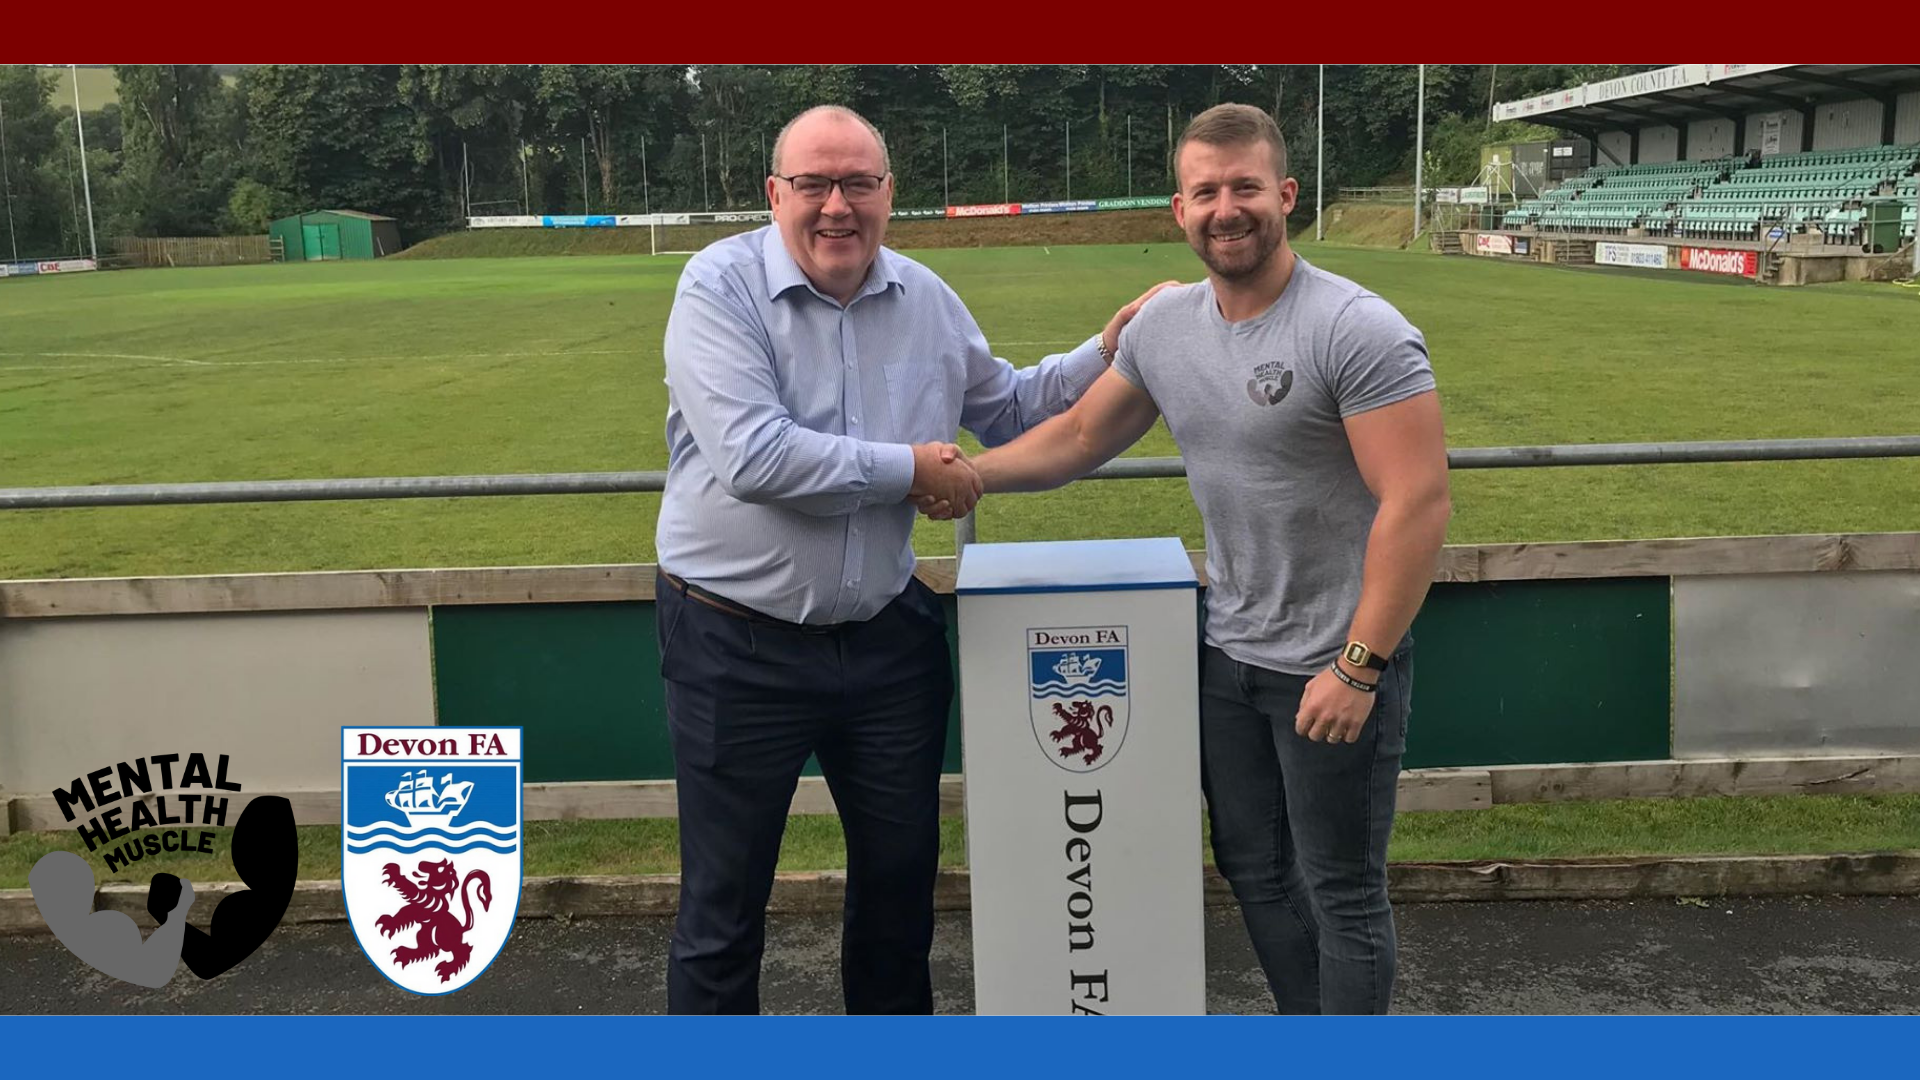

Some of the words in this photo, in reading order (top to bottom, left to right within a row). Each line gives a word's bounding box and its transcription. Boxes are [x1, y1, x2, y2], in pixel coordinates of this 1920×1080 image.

[1600, 81, 1626, 99] DEVON
[1630, 72, 1667, 94] COUNTY
[1098, 200, 1135, 208] GRADDON
[1137, 198, 1170, 206] VENDING
[956, 206, 1010, 216] McDonald's
[1689, 248, 1744, 274] McDonald's
[1254, 361, 1285, 374] MENTAL
[1035, 631, 1090, 645] Devon
[1095, 630, 1120, 644] FA
[1064, 789, 1103, 953] Devon
